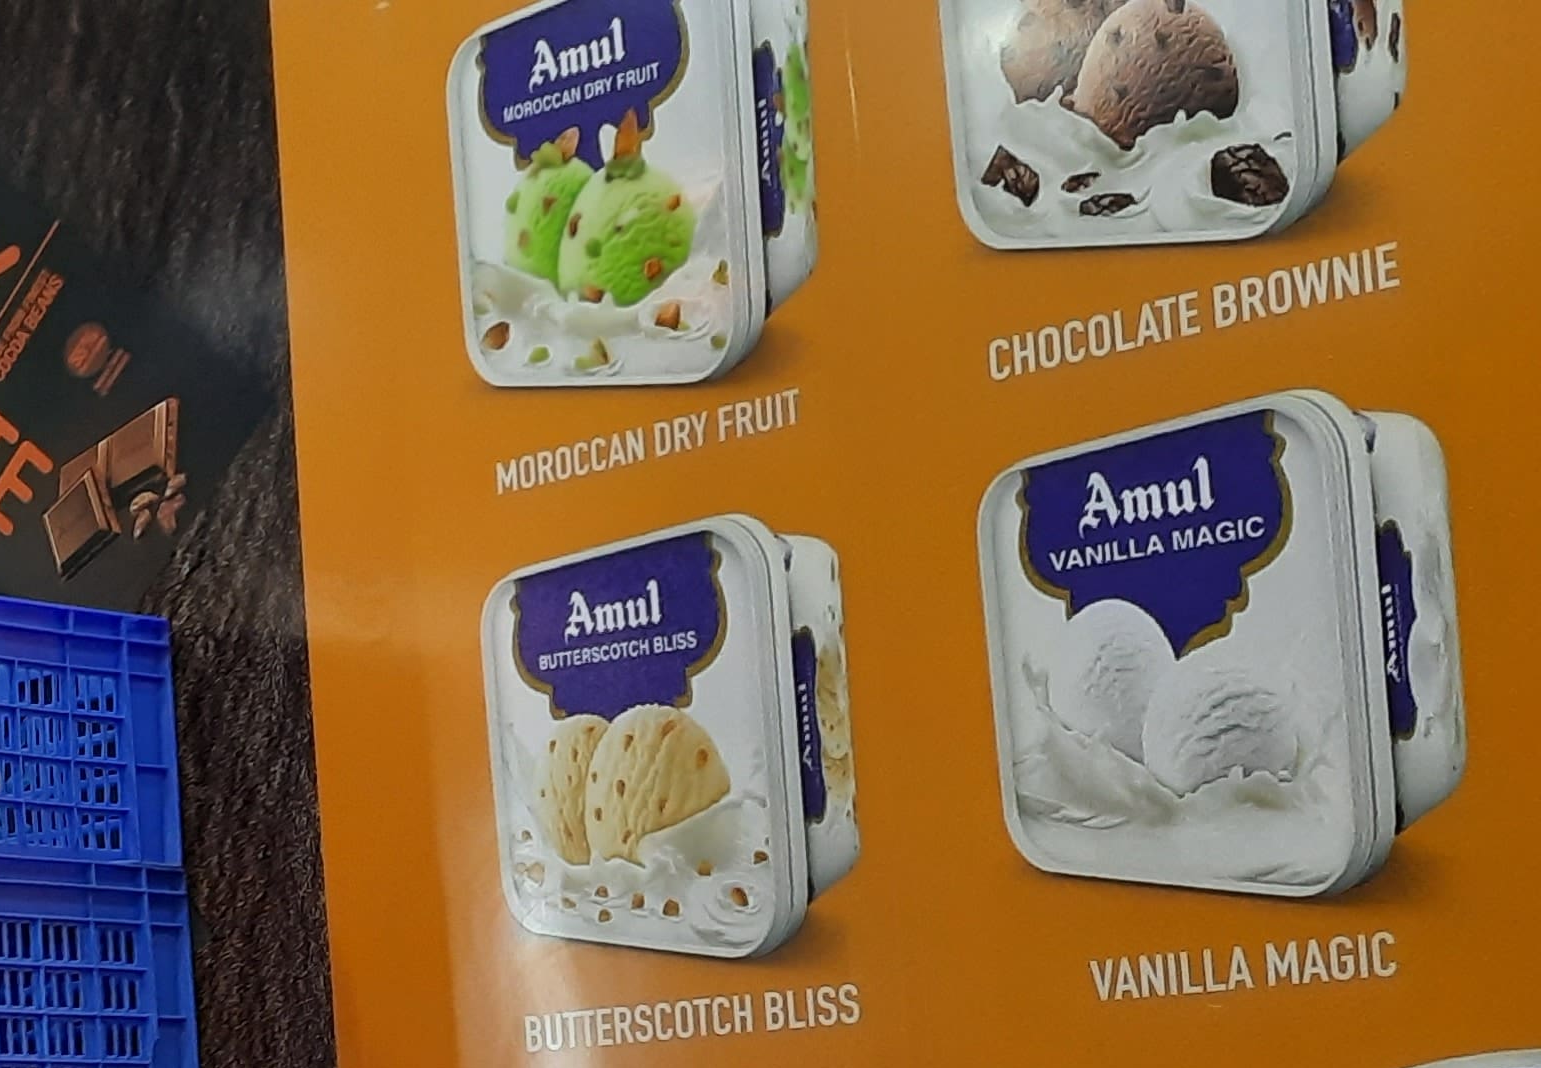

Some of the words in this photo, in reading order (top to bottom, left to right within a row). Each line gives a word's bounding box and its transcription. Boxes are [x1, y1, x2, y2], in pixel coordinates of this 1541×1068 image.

[528, 16, 626, 94] Amul
[502, 87, 582, 125] MOROCCAN
[583, 76, 613, 102] DRY
[616, 61, 661, 92] FRUIT
[988, 291, 1202, 382] CHOCOLATE
[1212, 242, 1401, 330] BROWNIE
[495, 426, 646, 495] MOROCCAN
[653, 410, 709, 458] DRY
[717, 387, 800, 443] FRUIT
[1077, 455, 1216, 540] Amul
[1048, 537, 1165, 573] VANILLA
[1172, 516, 1266, 552] MAGIC
[563, 578, 663, 643] Amul
[538, 637, 650, 671] BUTTERSCOTCH
[652, 629, 698, 653] BLISS
[1089, 944, 1254, 1002] VANILLA
[1263, 930, 1398, 985] MAGIC
[523, 994, 755, 1054] BUTTERSCOTCH
[763, 982, 862, 1030] BLISS
